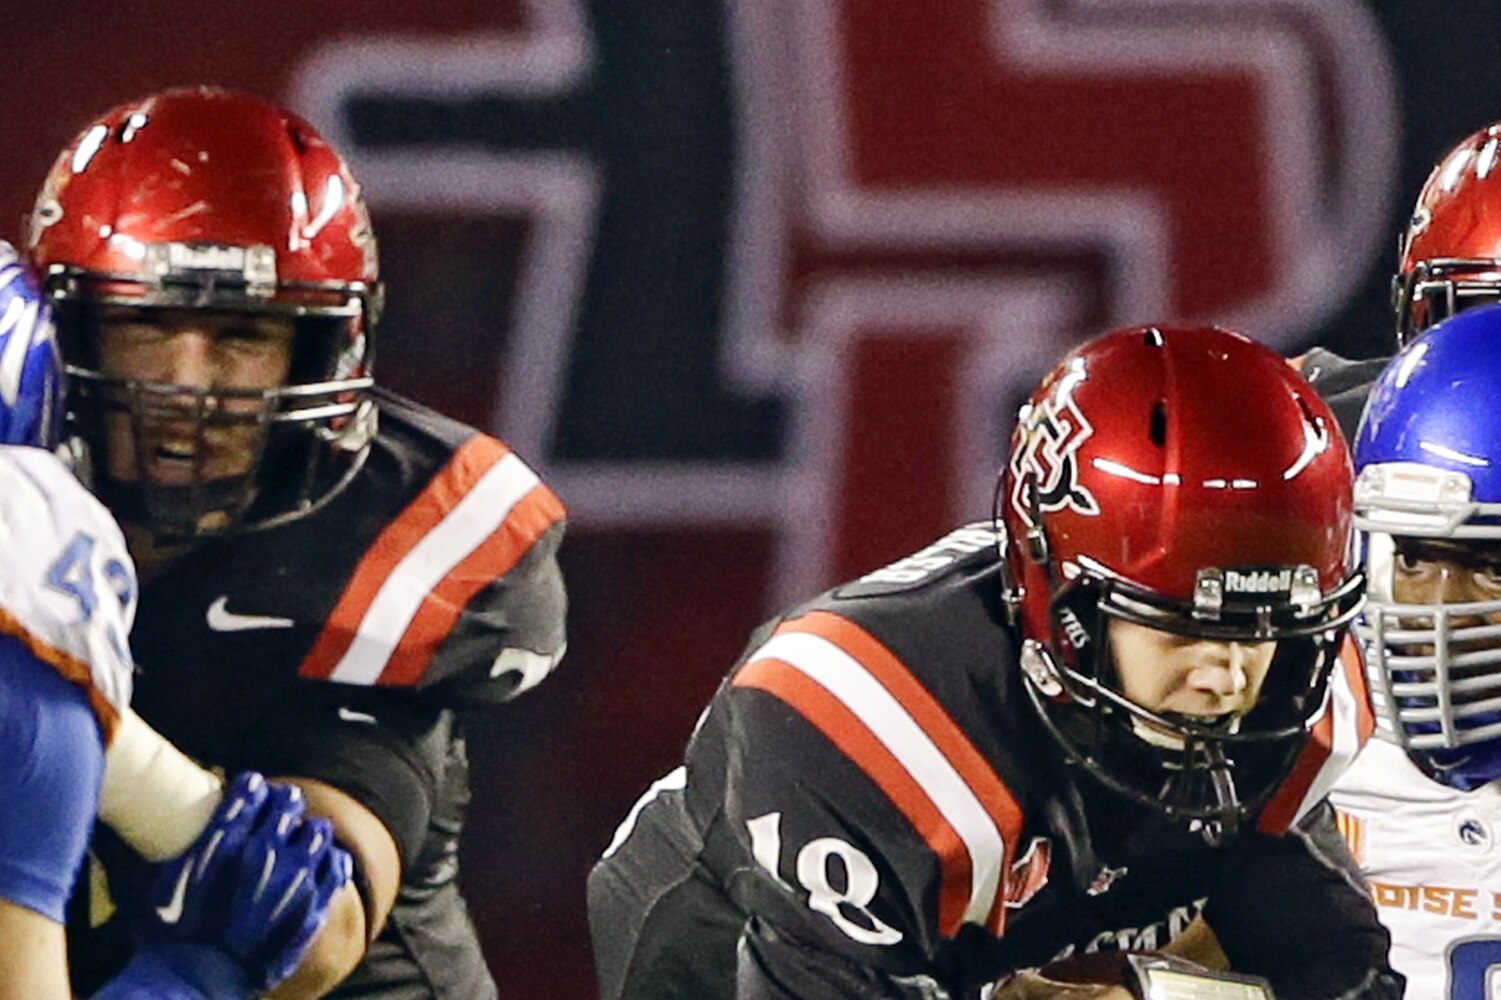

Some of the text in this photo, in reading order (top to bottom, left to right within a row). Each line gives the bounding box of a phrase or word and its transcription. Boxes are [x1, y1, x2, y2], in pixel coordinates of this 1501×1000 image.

[1225, 570, 1292, 593] Riddell
[745, 811, 904, 946] 18
[1370, 883, 1480, 920] OISE
